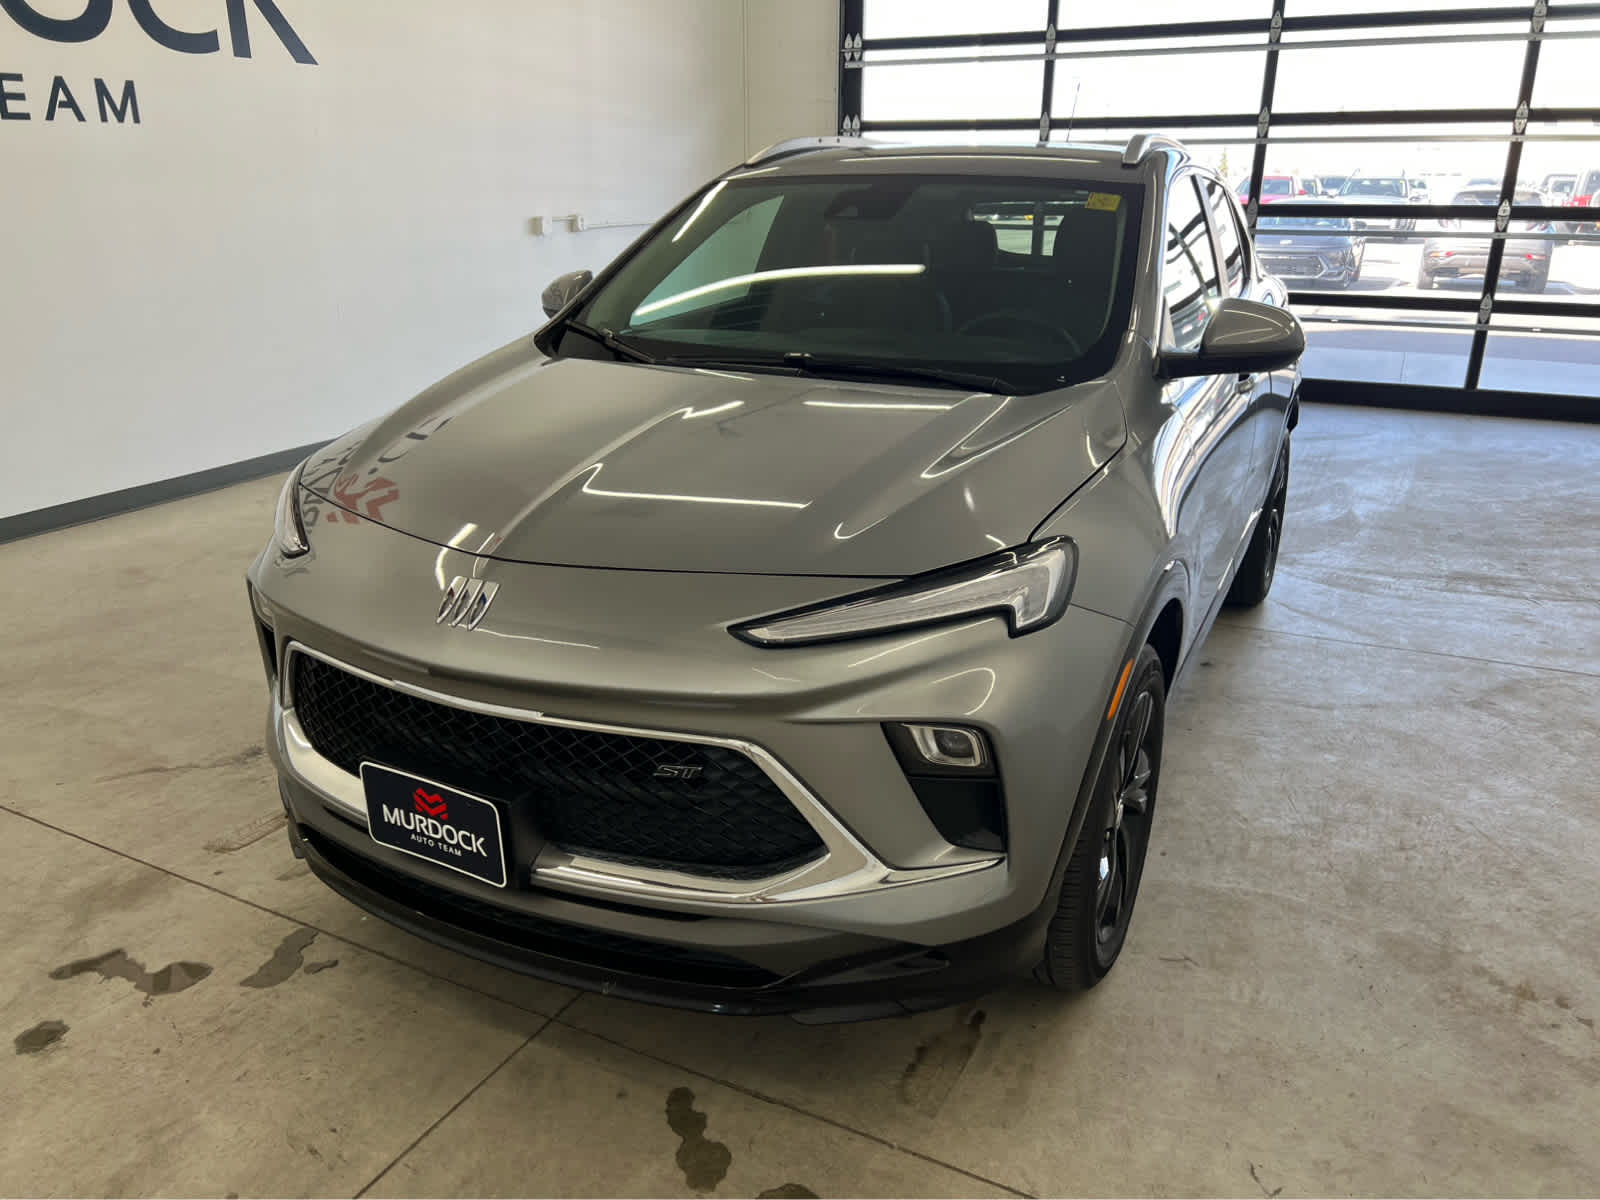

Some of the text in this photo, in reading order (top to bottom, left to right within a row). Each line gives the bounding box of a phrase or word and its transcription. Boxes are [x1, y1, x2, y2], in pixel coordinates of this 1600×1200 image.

[0, 73, 140, 124] EAM
[382, 803, 487, 857] MURDOCK
[410, 833, 462, 857] AUTO TEAM
